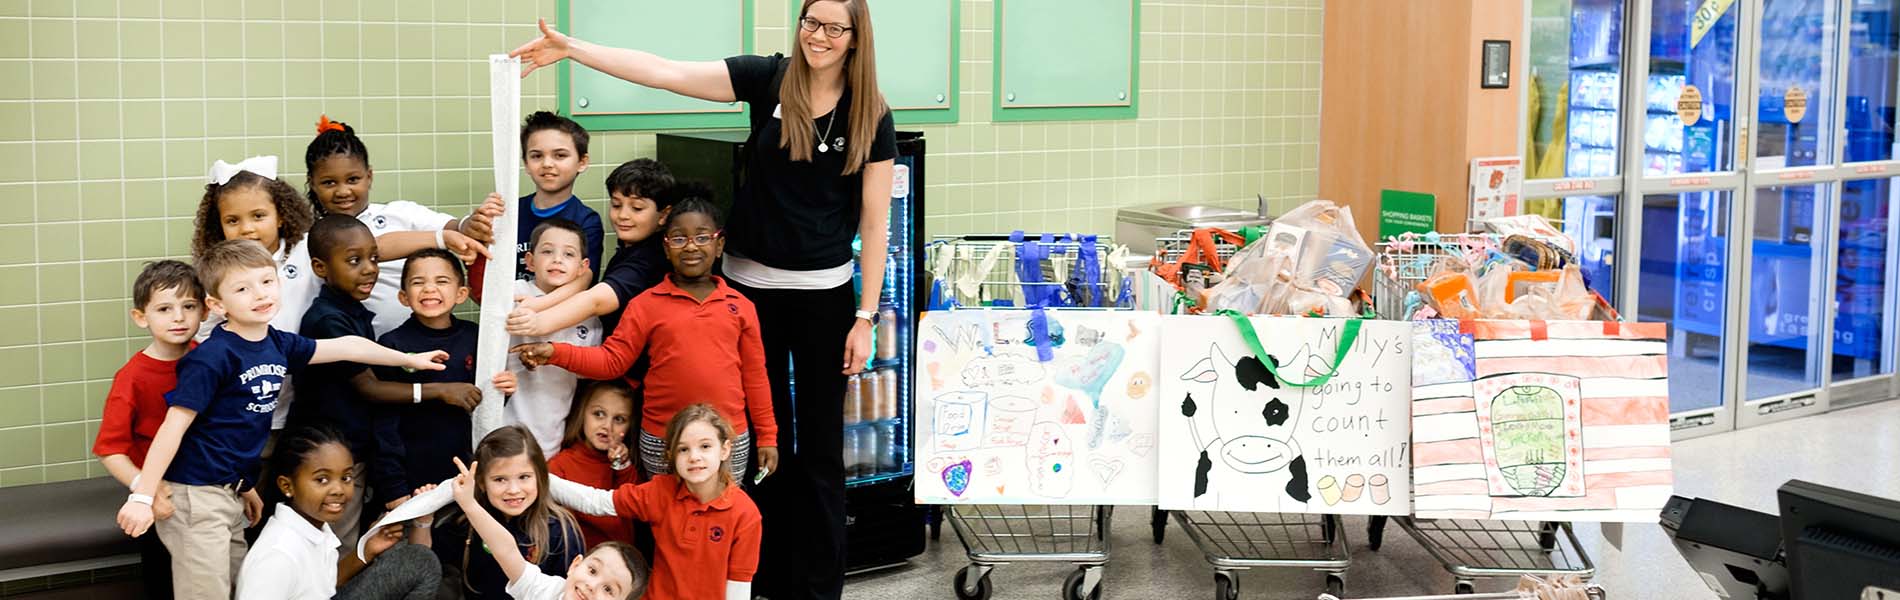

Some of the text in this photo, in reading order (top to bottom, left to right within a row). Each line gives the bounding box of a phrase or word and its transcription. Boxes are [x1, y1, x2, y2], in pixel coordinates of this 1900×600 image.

[1382, 210, 1433, 223] SHOPPING BASKETS
[1703, 251, 1722, 312] crisp
[1318, 325, 1403, 368] Mlly's
[239, 363, 288, 385] PRIMROSE
[1312, 376, 1393, 410] going to
[1311, 408, 1390, 433] count
[1314, 442, 1408, 468] them all!
